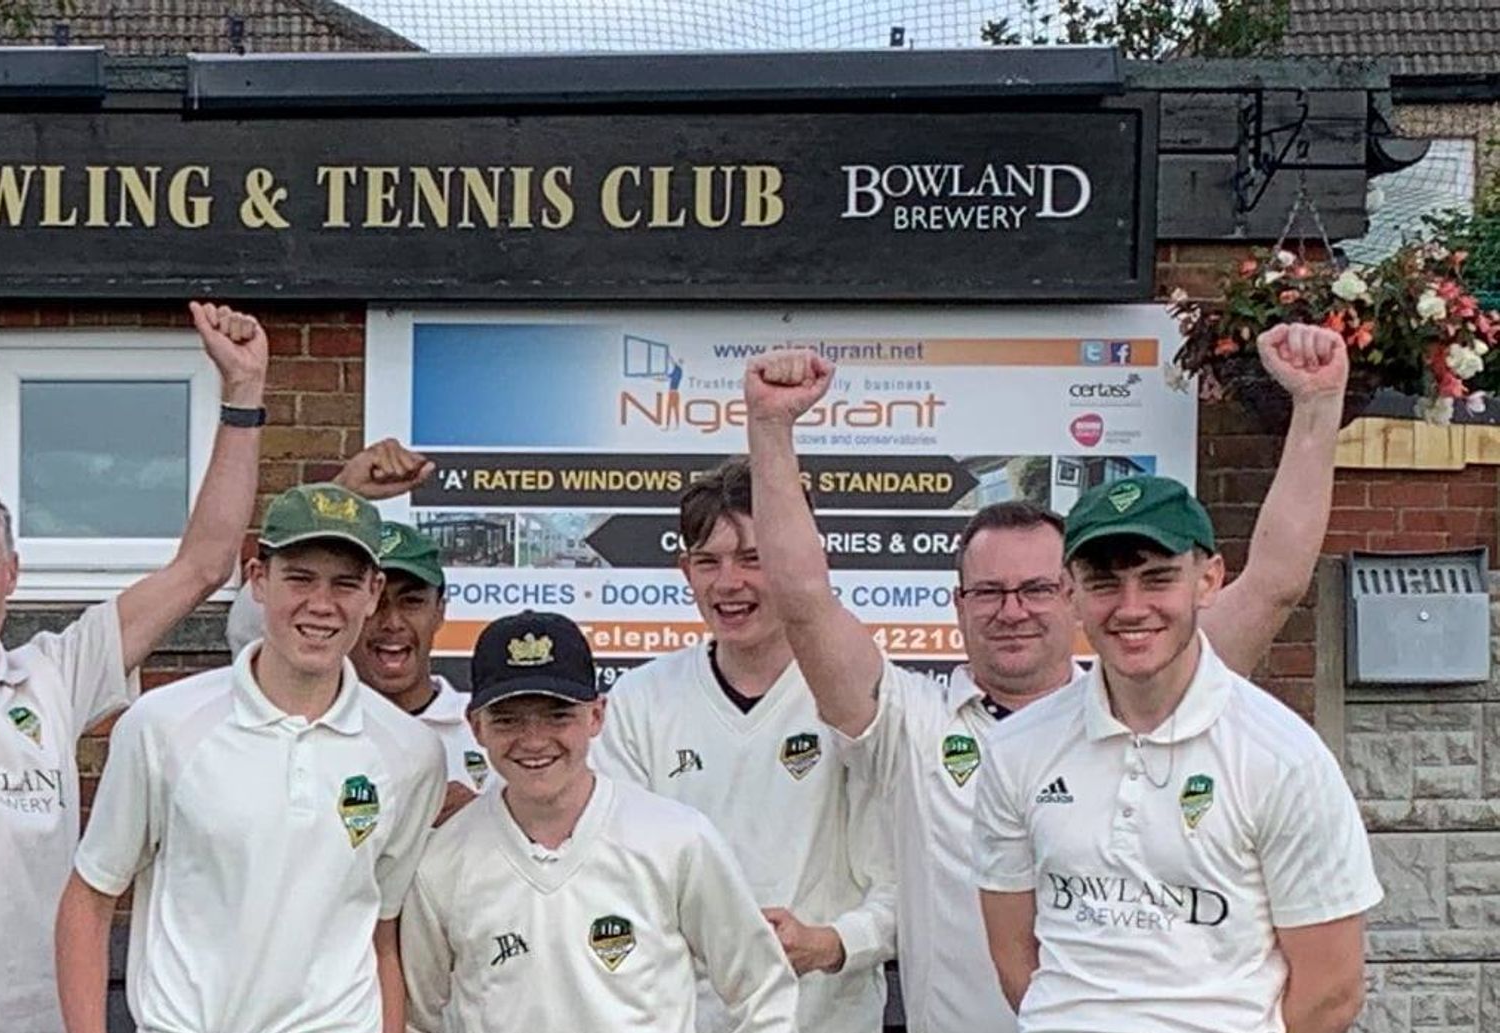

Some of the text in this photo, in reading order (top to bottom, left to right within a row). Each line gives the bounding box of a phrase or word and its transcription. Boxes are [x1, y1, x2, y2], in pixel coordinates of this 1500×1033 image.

[239, 167, 289, 229] &
[317, 164, 574, 230] TENNIS
[601, 164, 784, 228] CLUB
[841, 163, 1092, 218] BOWLAND
[894, 205, 1028, 230] BREWERY
[713, 341, 924, 363] wwwilgrant.net
[1069, 382, 1131, 398] certass
[473, 471, 554, 490] RATED
[560, 471, 682, 491] WINDOWS
[819, 472, 953, 492] STANDARD
[889, 533, 906, 553] &
[446, 583, 575, 605] PORCHES
[602, 584, 695, 606] DOORS
[852, 586, 951, 608] COMPO
[1048, 872, 1229, 927] BOWLAND
[1076, 903, 1177, 932] BREWERY
